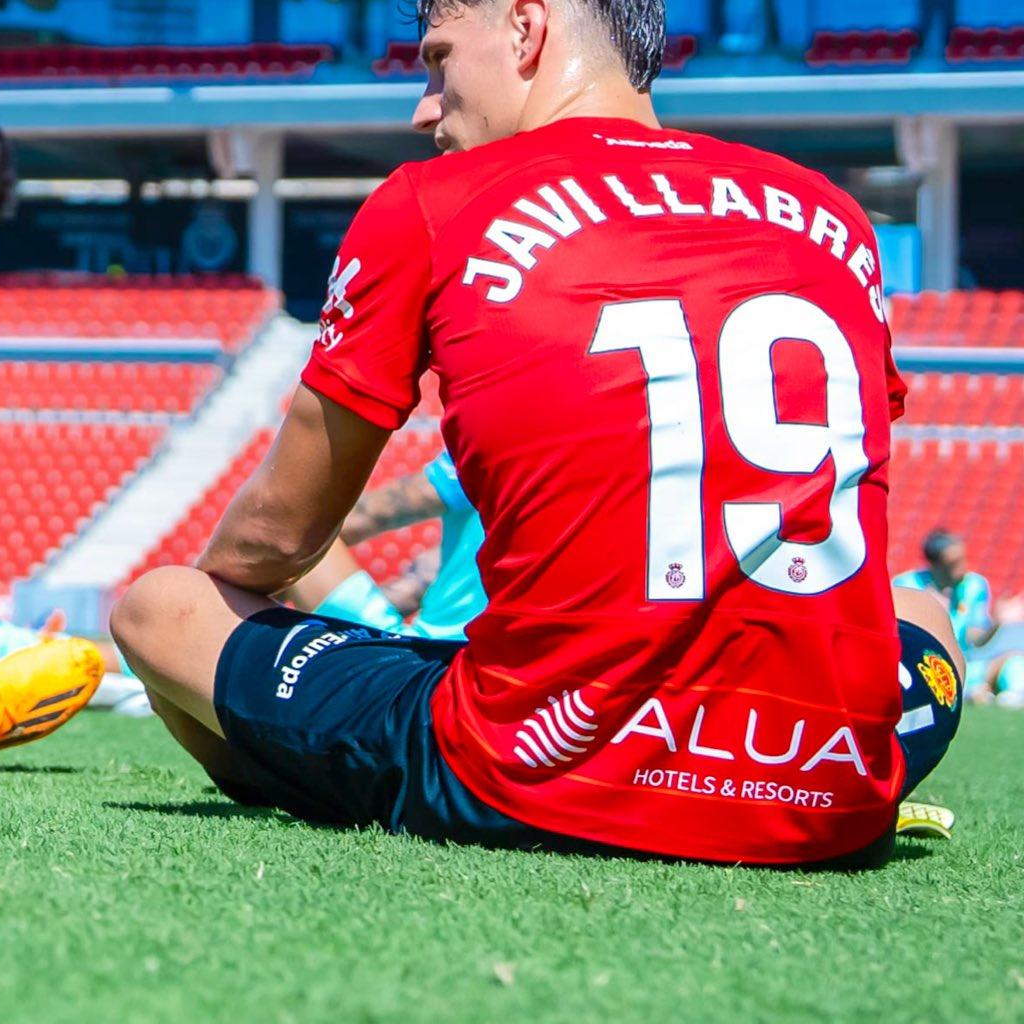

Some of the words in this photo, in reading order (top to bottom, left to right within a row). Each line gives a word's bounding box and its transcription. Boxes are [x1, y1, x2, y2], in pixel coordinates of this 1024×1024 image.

[462, 177, 607, 304] JAVI
[587, 292, 870, 601] 19
[610, 697, 869, 776] ALUA
[632, 768, 717, 795] HOTELS
[720, 778, 737, 797] &
[740, 780, 834, 808] RESORTS
